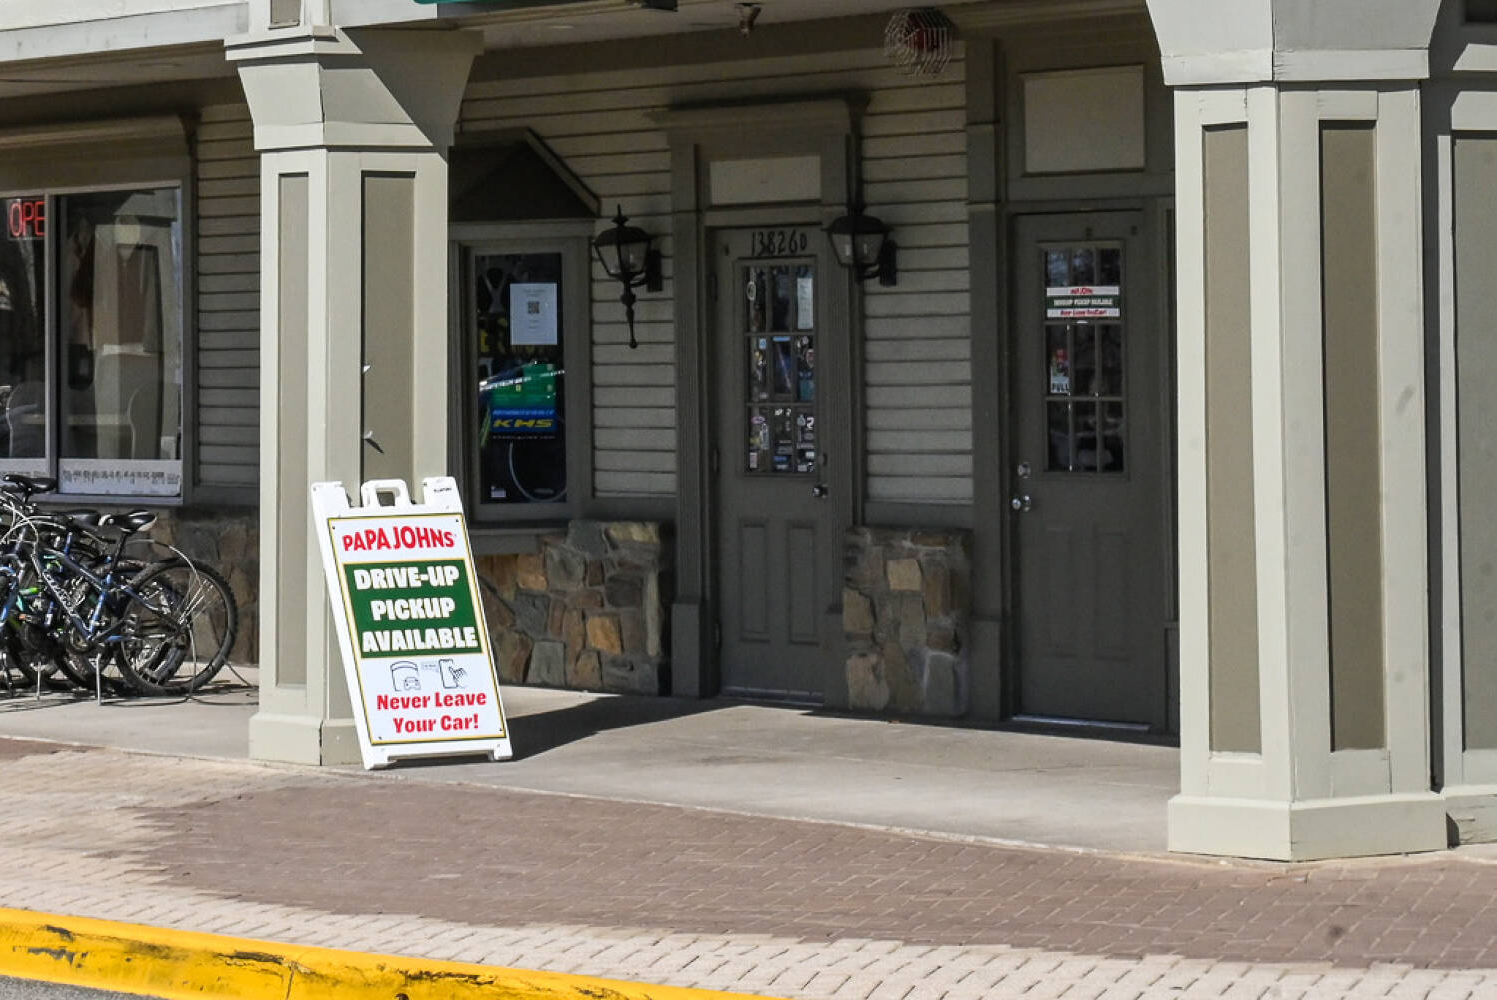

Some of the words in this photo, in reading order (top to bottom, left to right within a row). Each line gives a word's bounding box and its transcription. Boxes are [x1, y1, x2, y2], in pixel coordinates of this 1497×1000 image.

[9, 201, 47, 238] OPE
[492, 418, 554, 428] KHS
[342, 527, 389, 551] PAPA
[392, 525, 454, 550] JOHNS
[353, 565, 460, 590] DRIVE-UP
[370, 597, 456, 621] PICKUP
[361, 627, 478, 653] AVAILABLE
[376, 694, 431, 711] Never
[434, 691, 488, 708] Leave
[392, 716, 437, 733] Your
[440, 713, 479, 731] Car!
